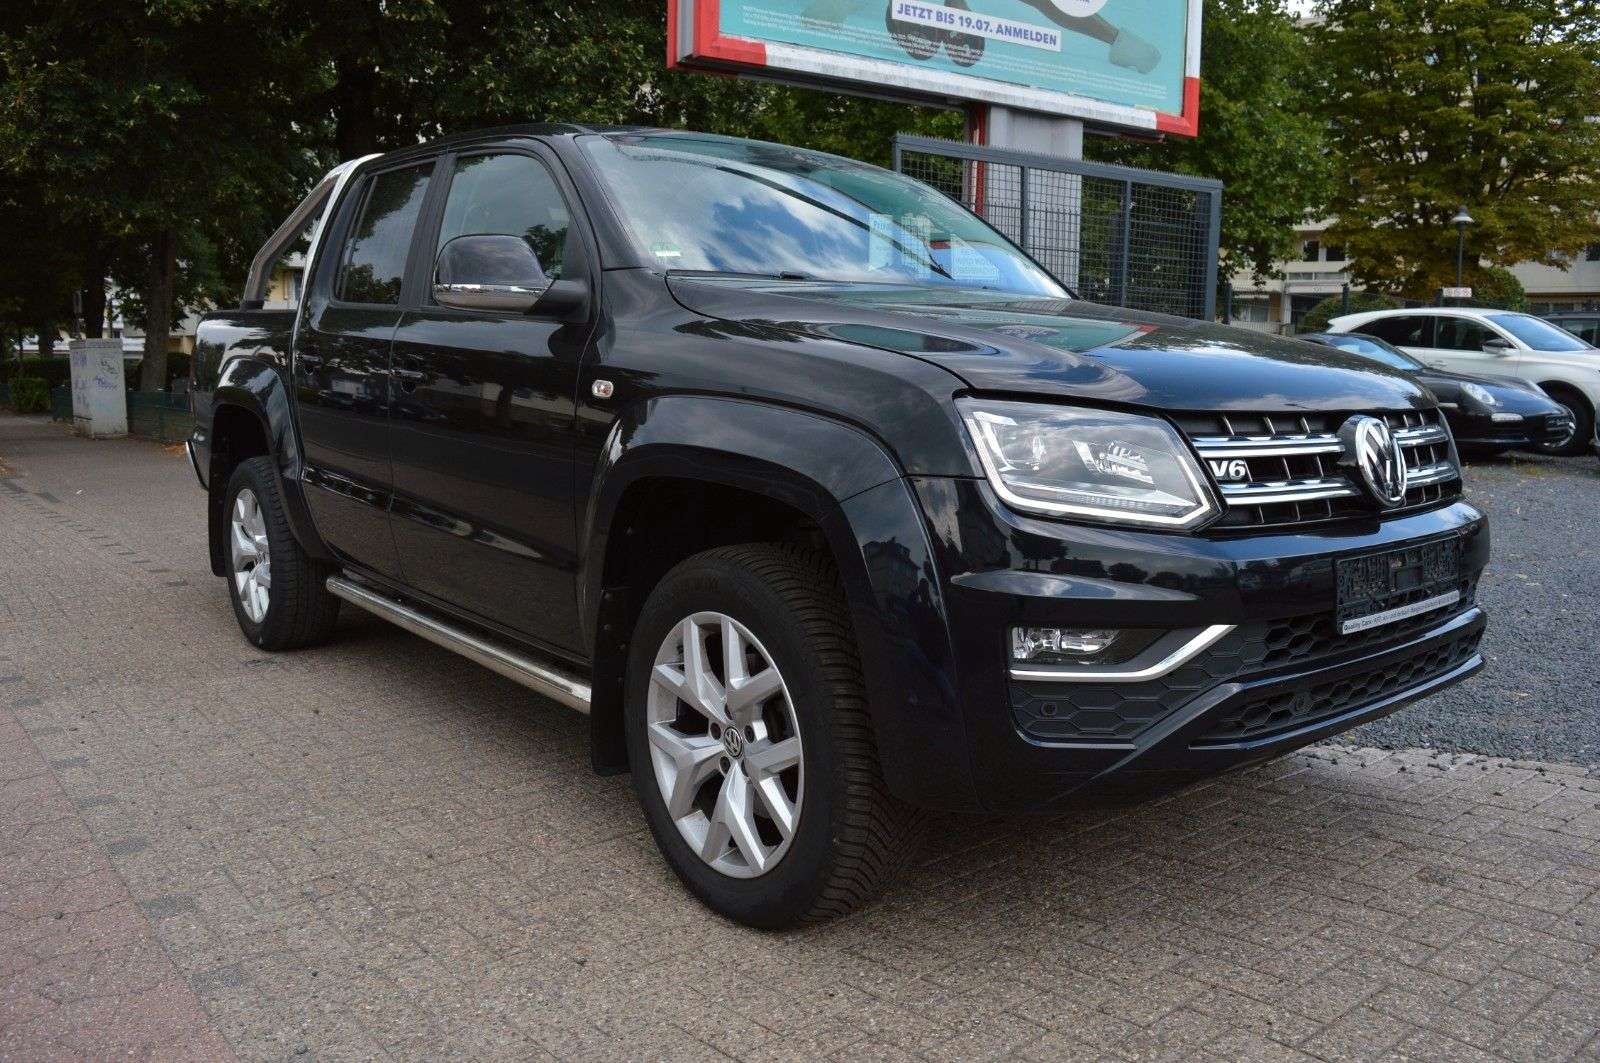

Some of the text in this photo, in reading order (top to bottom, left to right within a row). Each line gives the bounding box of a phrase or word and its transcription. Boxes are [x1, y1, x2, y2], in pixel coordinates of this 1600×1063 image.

[897, 3, 1057, 46] JETZT BIS 19.07. ANMELDEN
[1208, 459, 1246, 480] V6
